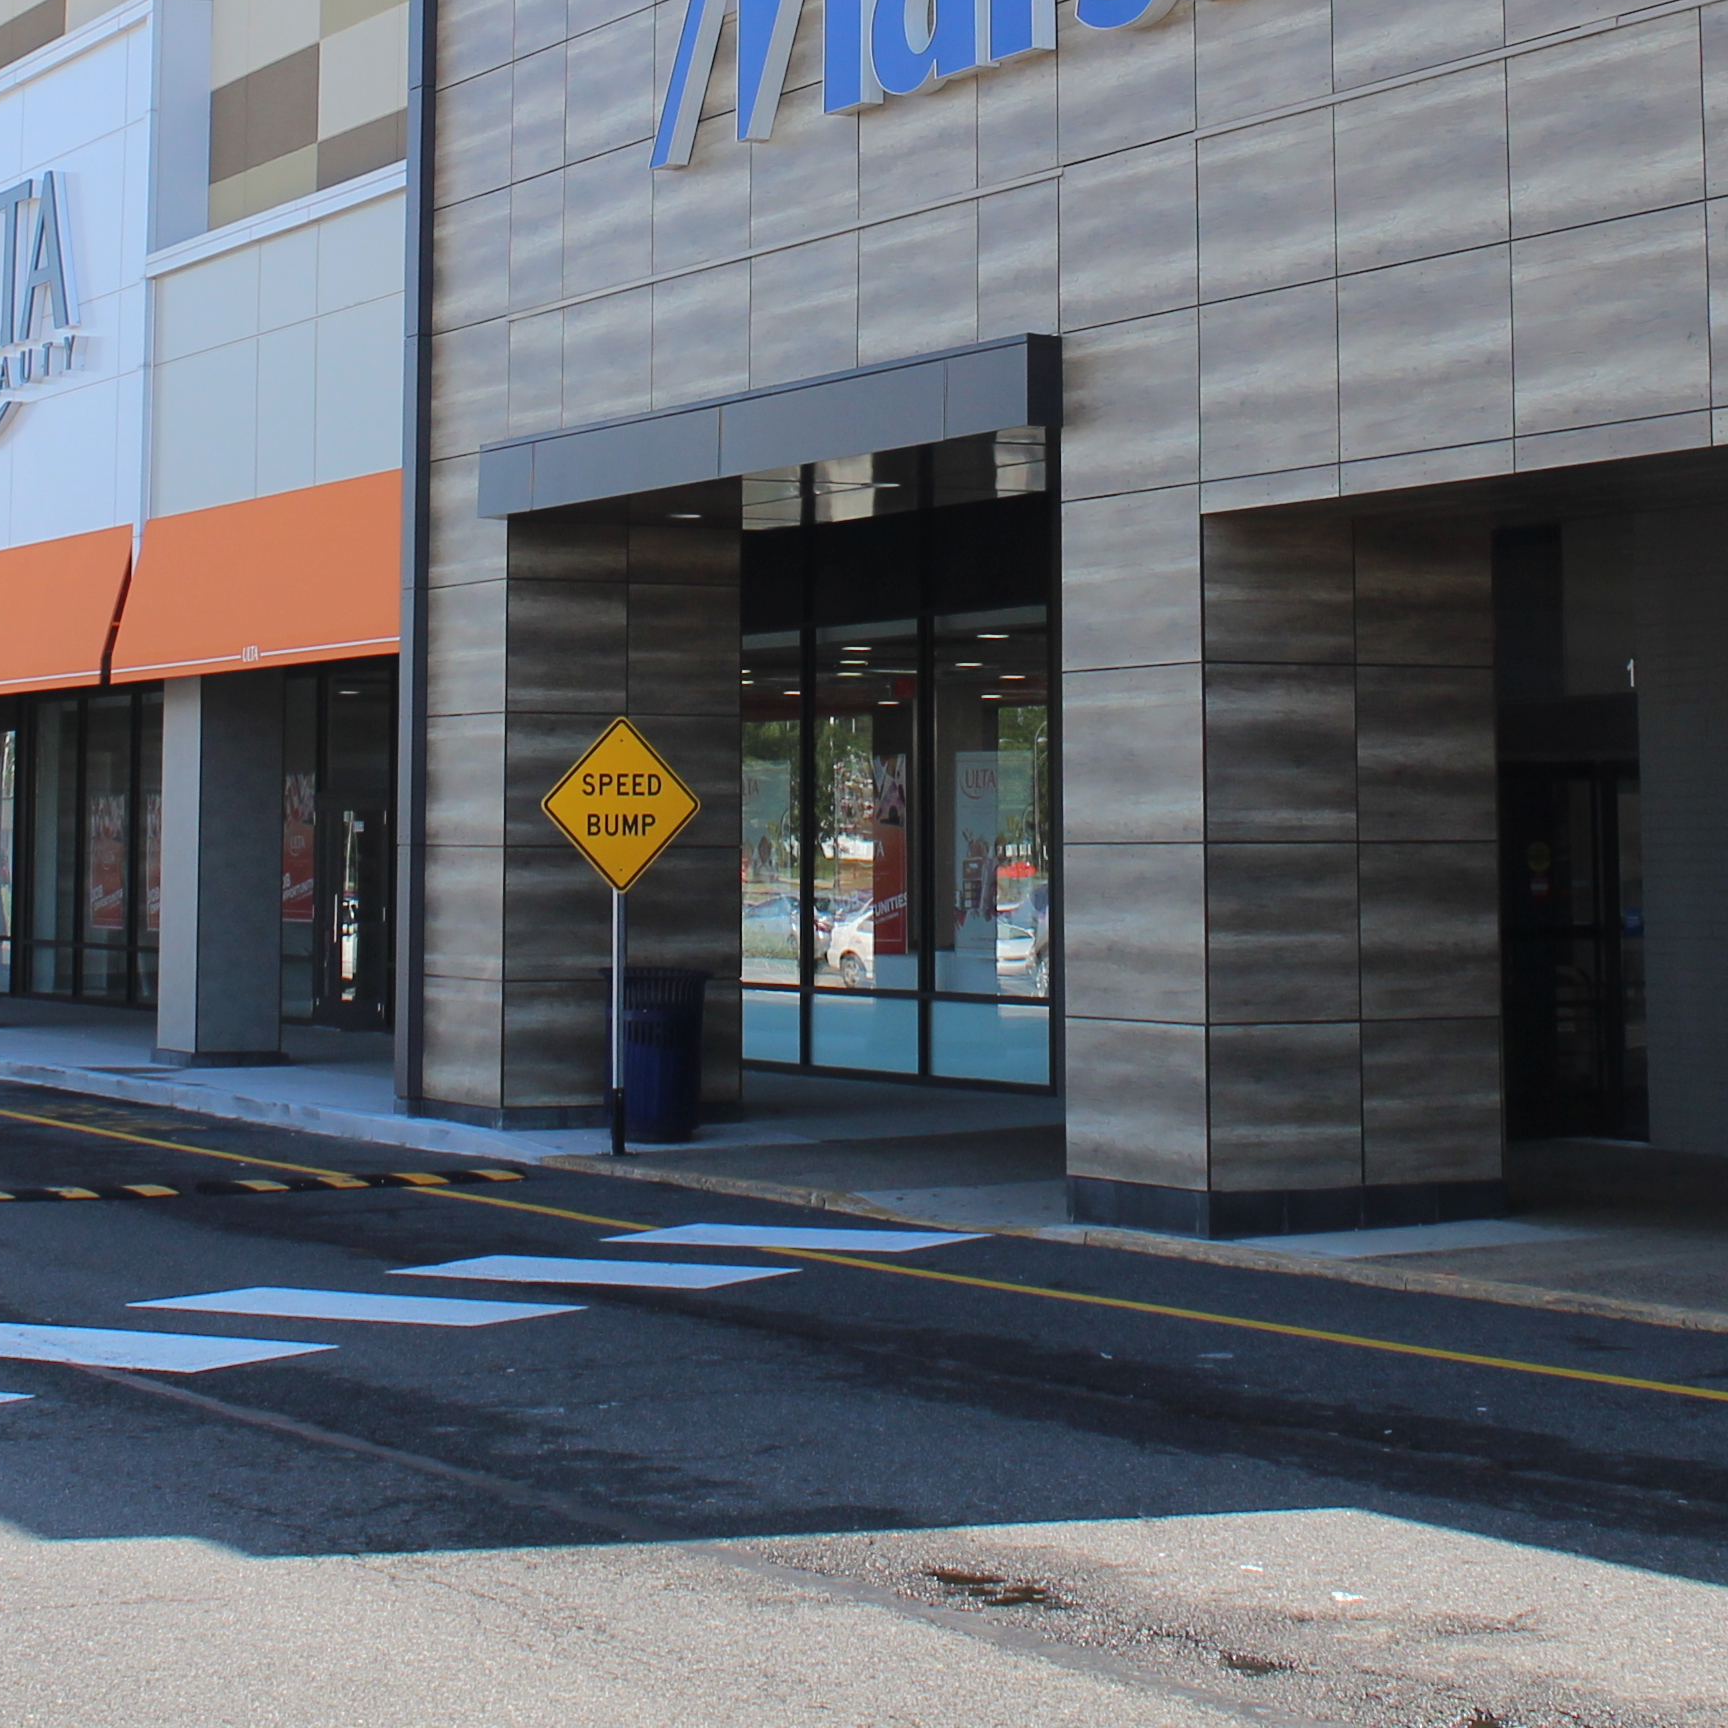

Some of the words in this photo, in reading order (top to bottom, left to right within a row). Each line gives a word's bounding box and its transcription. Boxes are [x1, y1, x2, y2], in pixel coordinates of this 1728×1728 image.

[242, 645, 259, 663] ULTA
[1626, 658, 1635, 688] 1
[581, 773, 662, 797] SPEED
[965, 768, 998, 789] ULTA
[587, 813, 657, 837] BUMP
